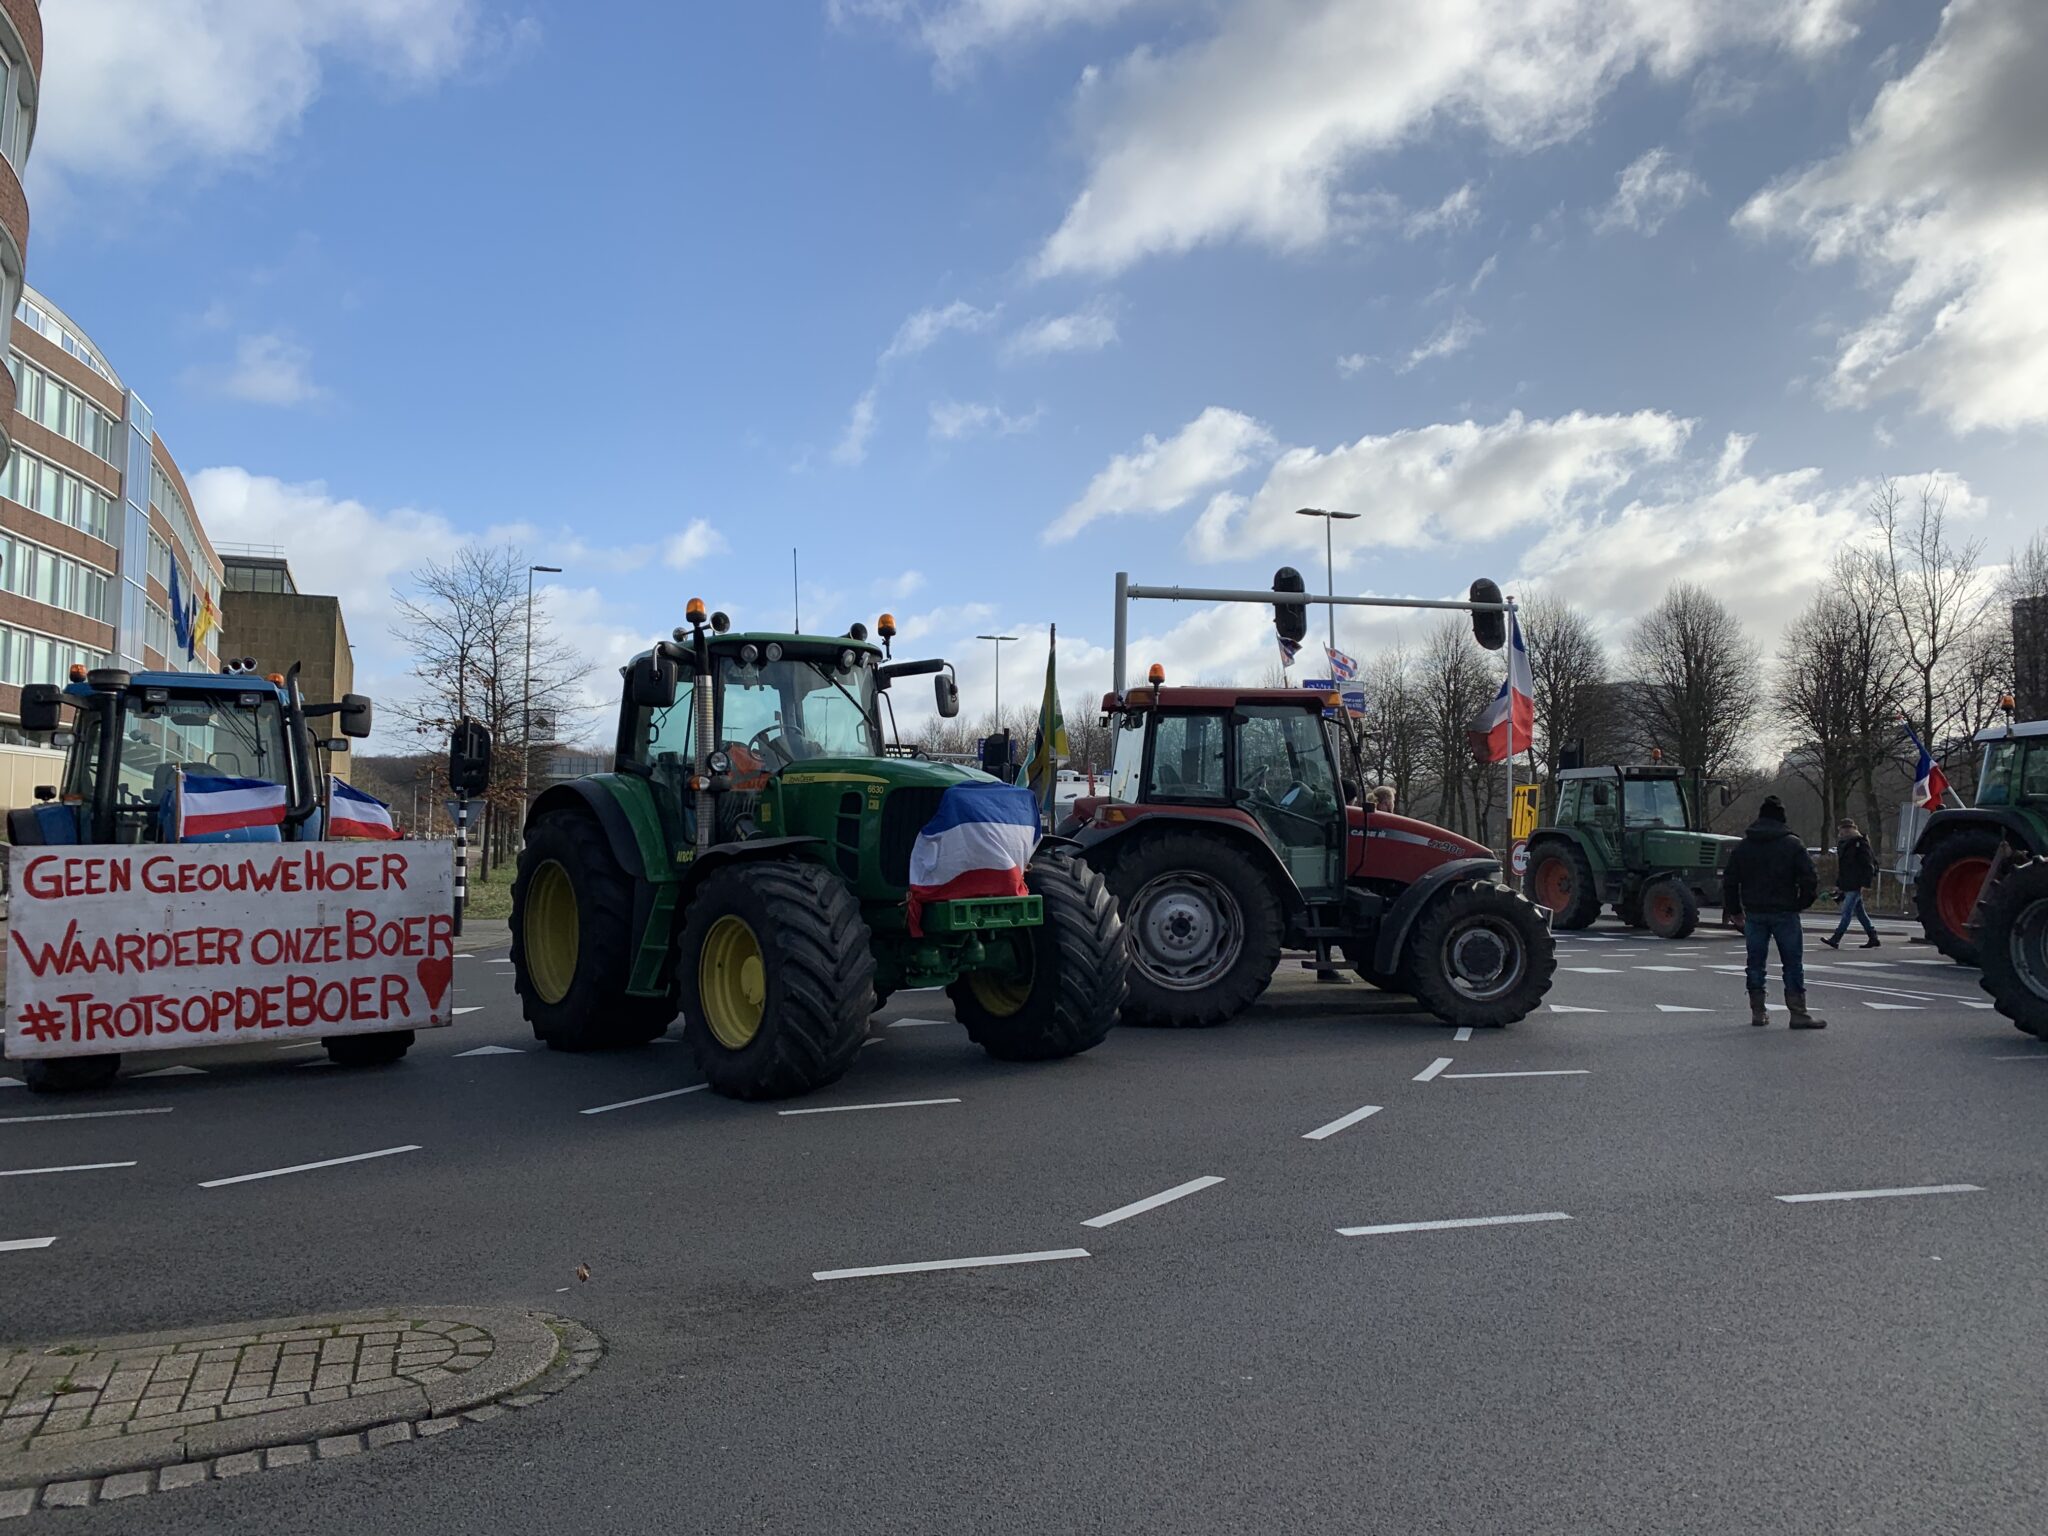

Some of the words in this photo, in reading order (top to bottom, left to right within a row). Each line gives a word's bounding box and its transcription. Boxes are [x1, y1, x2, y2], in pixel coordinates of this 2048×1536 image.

[867, 784, 884, 794] 6630
[23, 854, 131, 900] GEEN
[141, 849, 408, 893] GEOUWEHOER
[10, 918, 244, 977] WAARDEER
